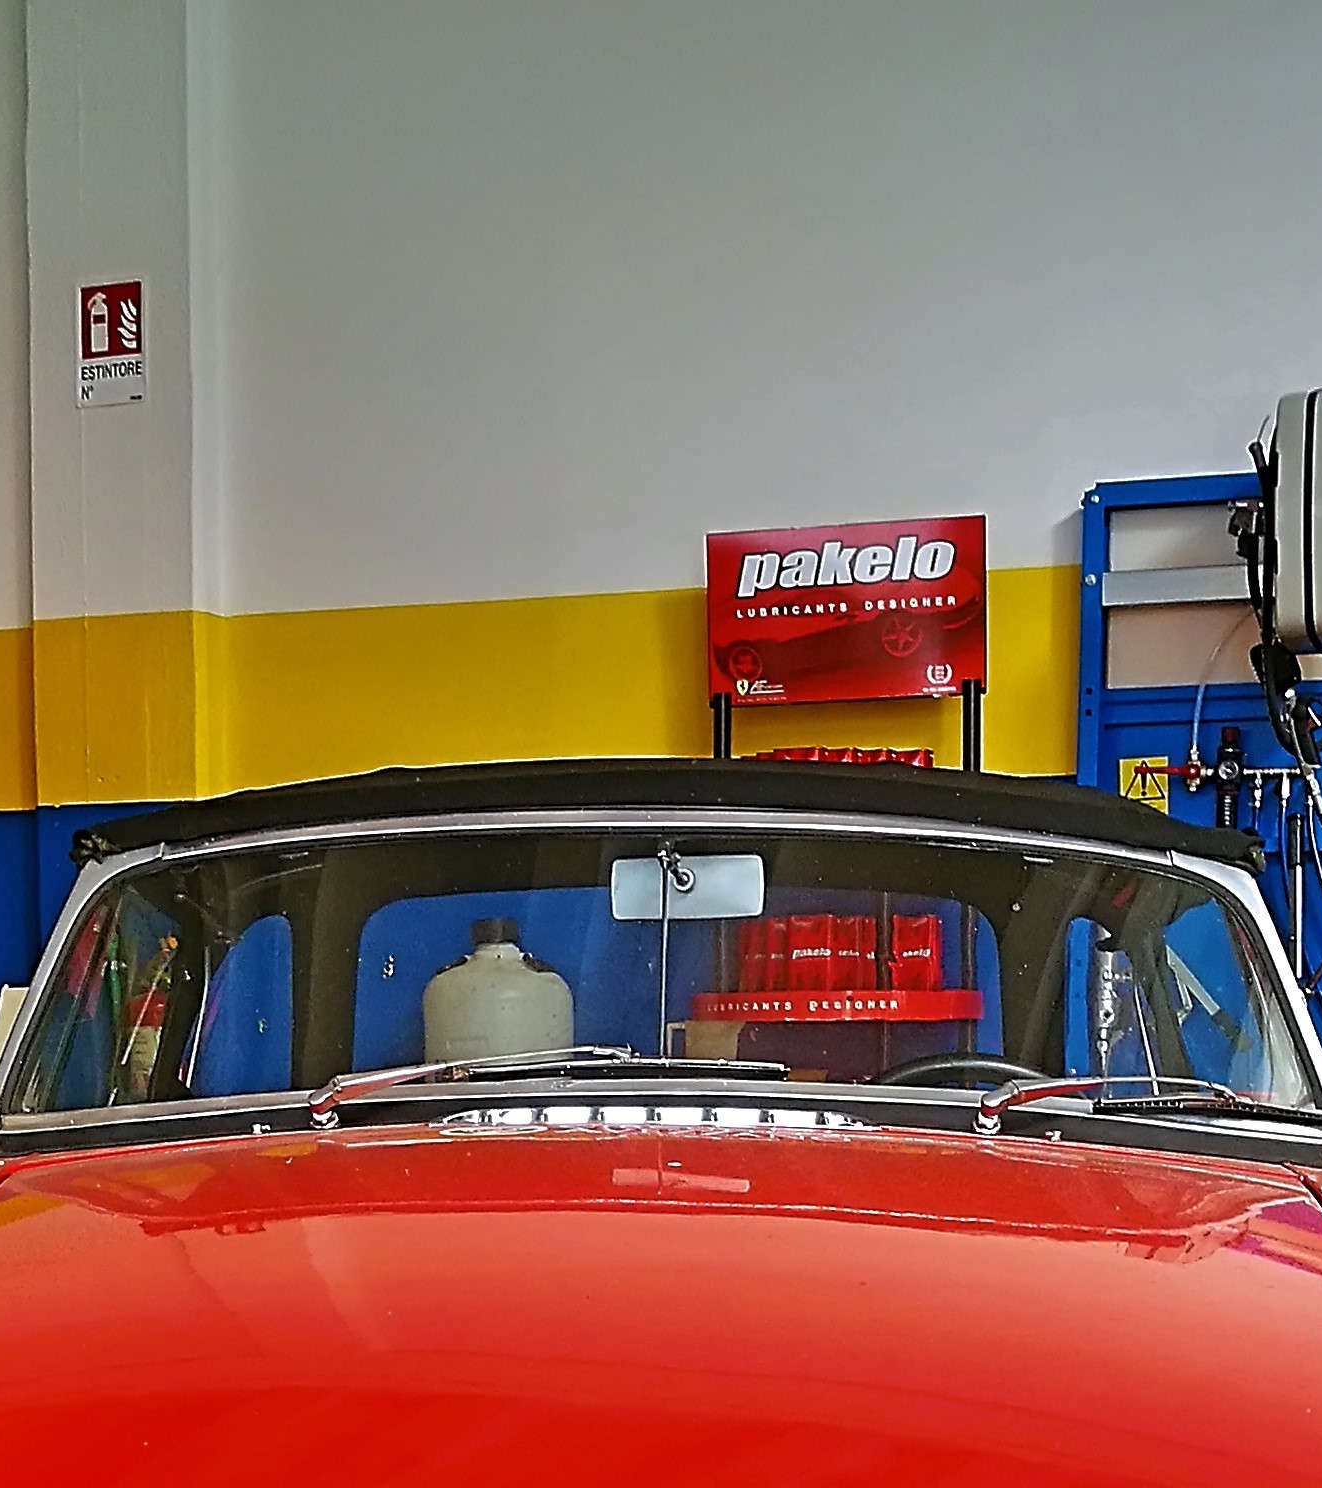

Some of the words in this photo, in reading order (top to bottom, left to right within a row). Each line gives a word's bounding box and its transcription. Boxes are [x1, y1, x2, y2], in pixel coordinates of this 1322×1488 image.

[81, 361, 142, 381] ESTINTORE
[737, 536, 955, 598] pakelo
[735, 602, 849, 619] LUBRICANTS
[864, 595, 957, 611] DESIGNER
[808, 999, 899, 1012] DESIGNER
